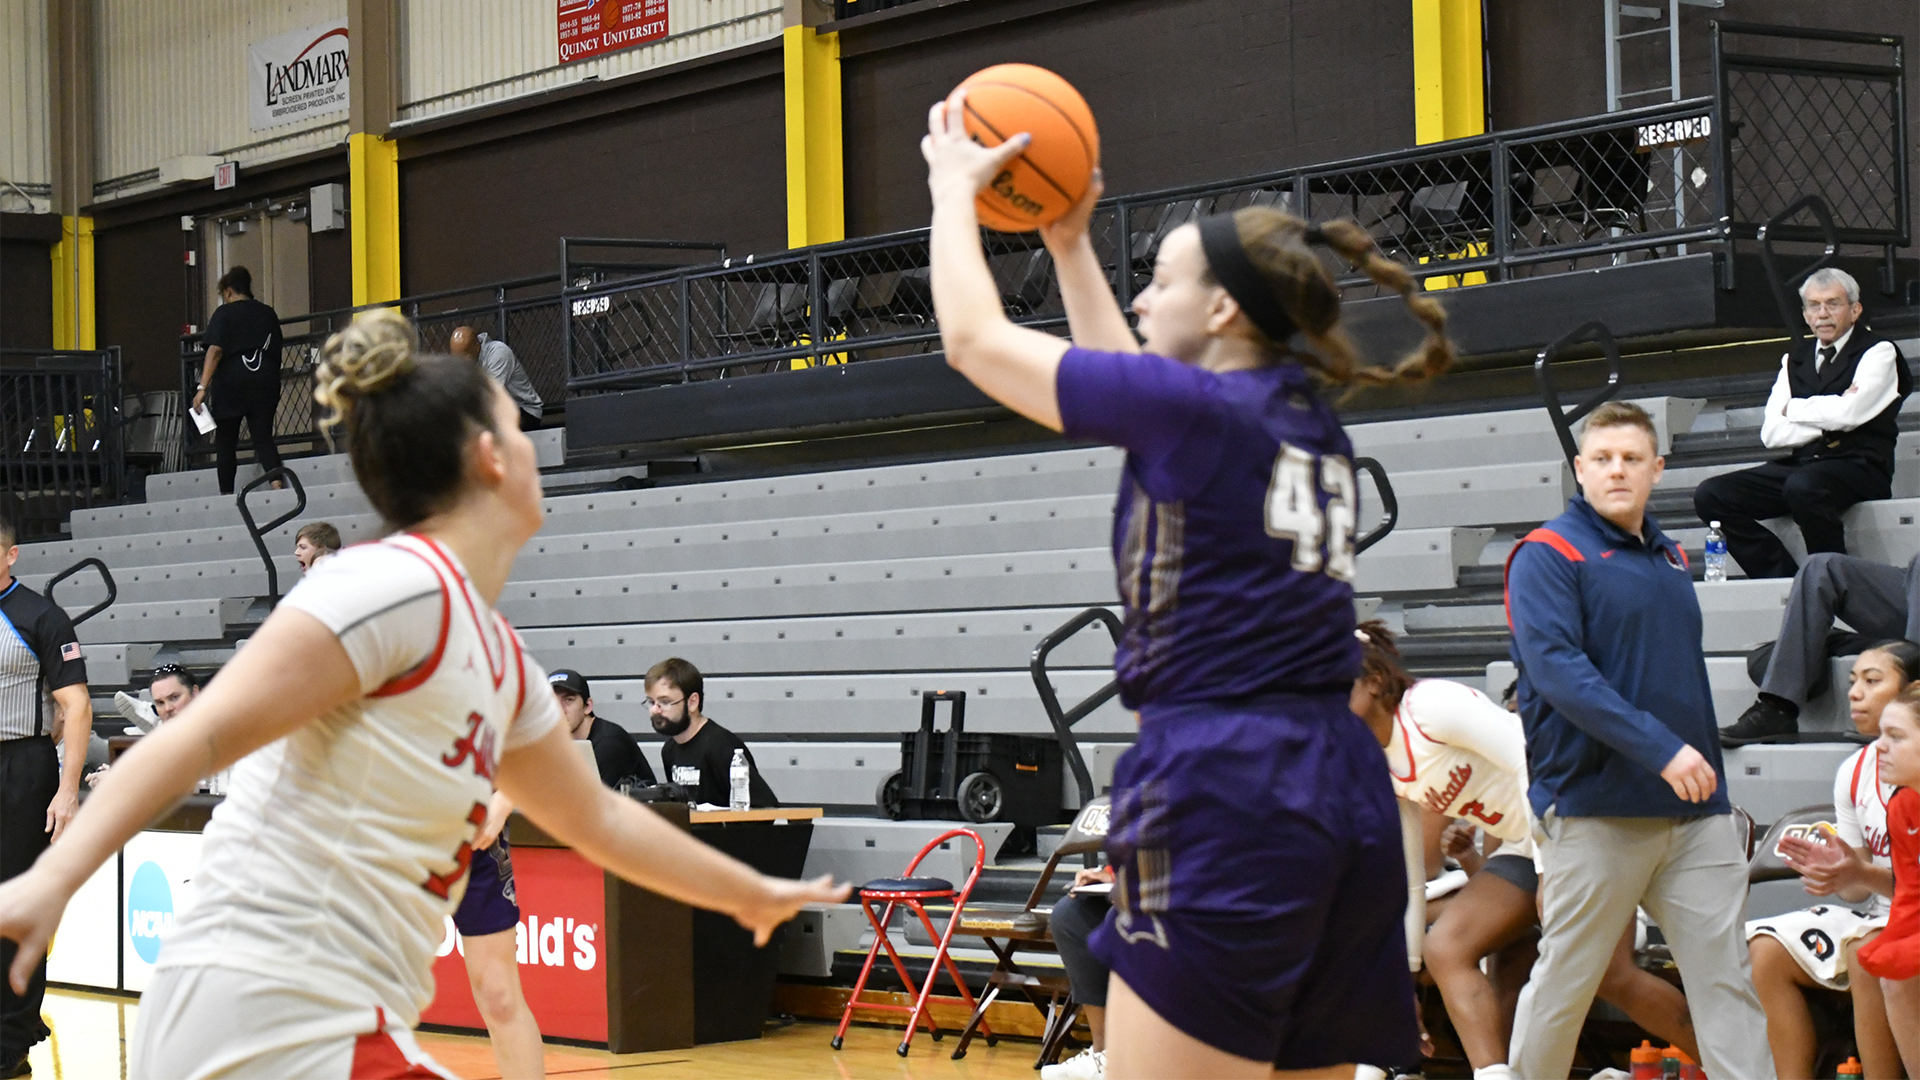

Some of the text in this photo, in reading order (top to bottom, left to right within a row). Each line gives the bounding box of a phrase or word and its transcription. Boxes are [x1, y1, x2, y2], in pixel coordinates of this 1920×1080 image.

[560, 20, 666, 61] QUINCY UNIVERSITY
[272, 92, 346, 118] EMBROIDERED PRODUCTS INC
[282, 85, 336, 106] SCREEN PRINTED AND
[1638, 116, 1711, 147] RESERVED
[991, 170, 1044, 216] lson
[1263, 440, 1357, 583] 42
